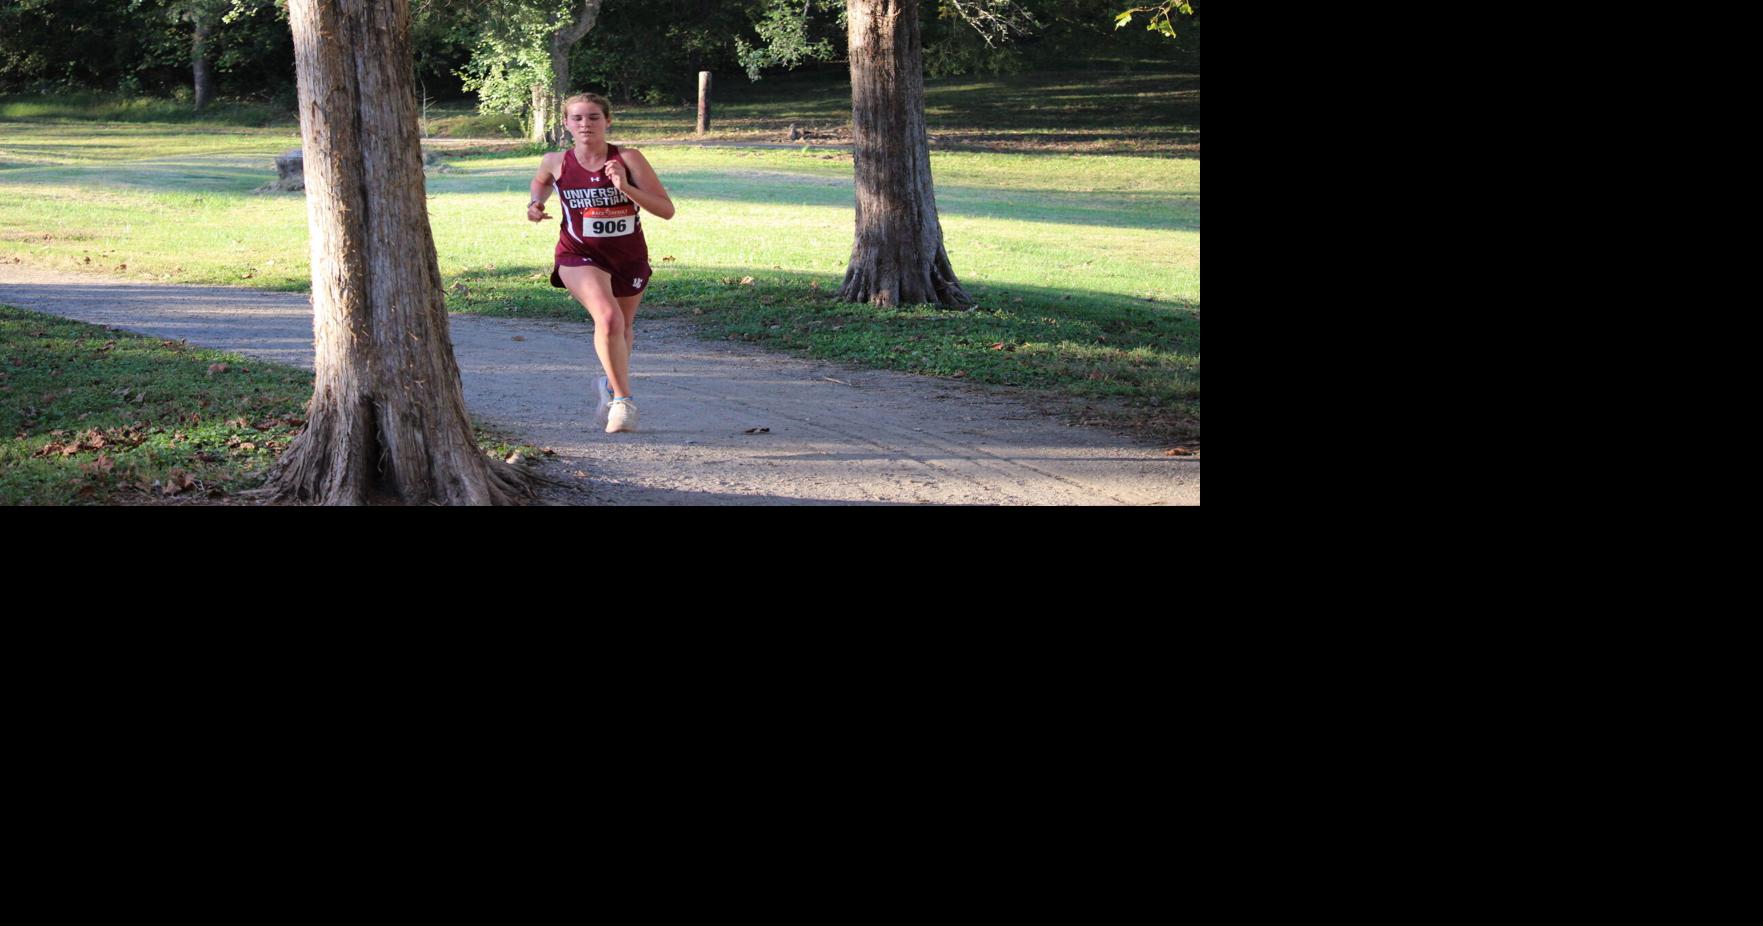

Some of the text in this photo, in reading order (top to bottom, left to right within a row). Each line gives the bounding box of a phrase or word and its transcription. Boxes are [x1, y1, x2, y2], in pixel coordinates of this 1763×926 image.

[563, 187, 621, 199] UNIVERSI
[569, 195, 628, 208] CHRISTIAN
[592, 219, 627, 235] 906
